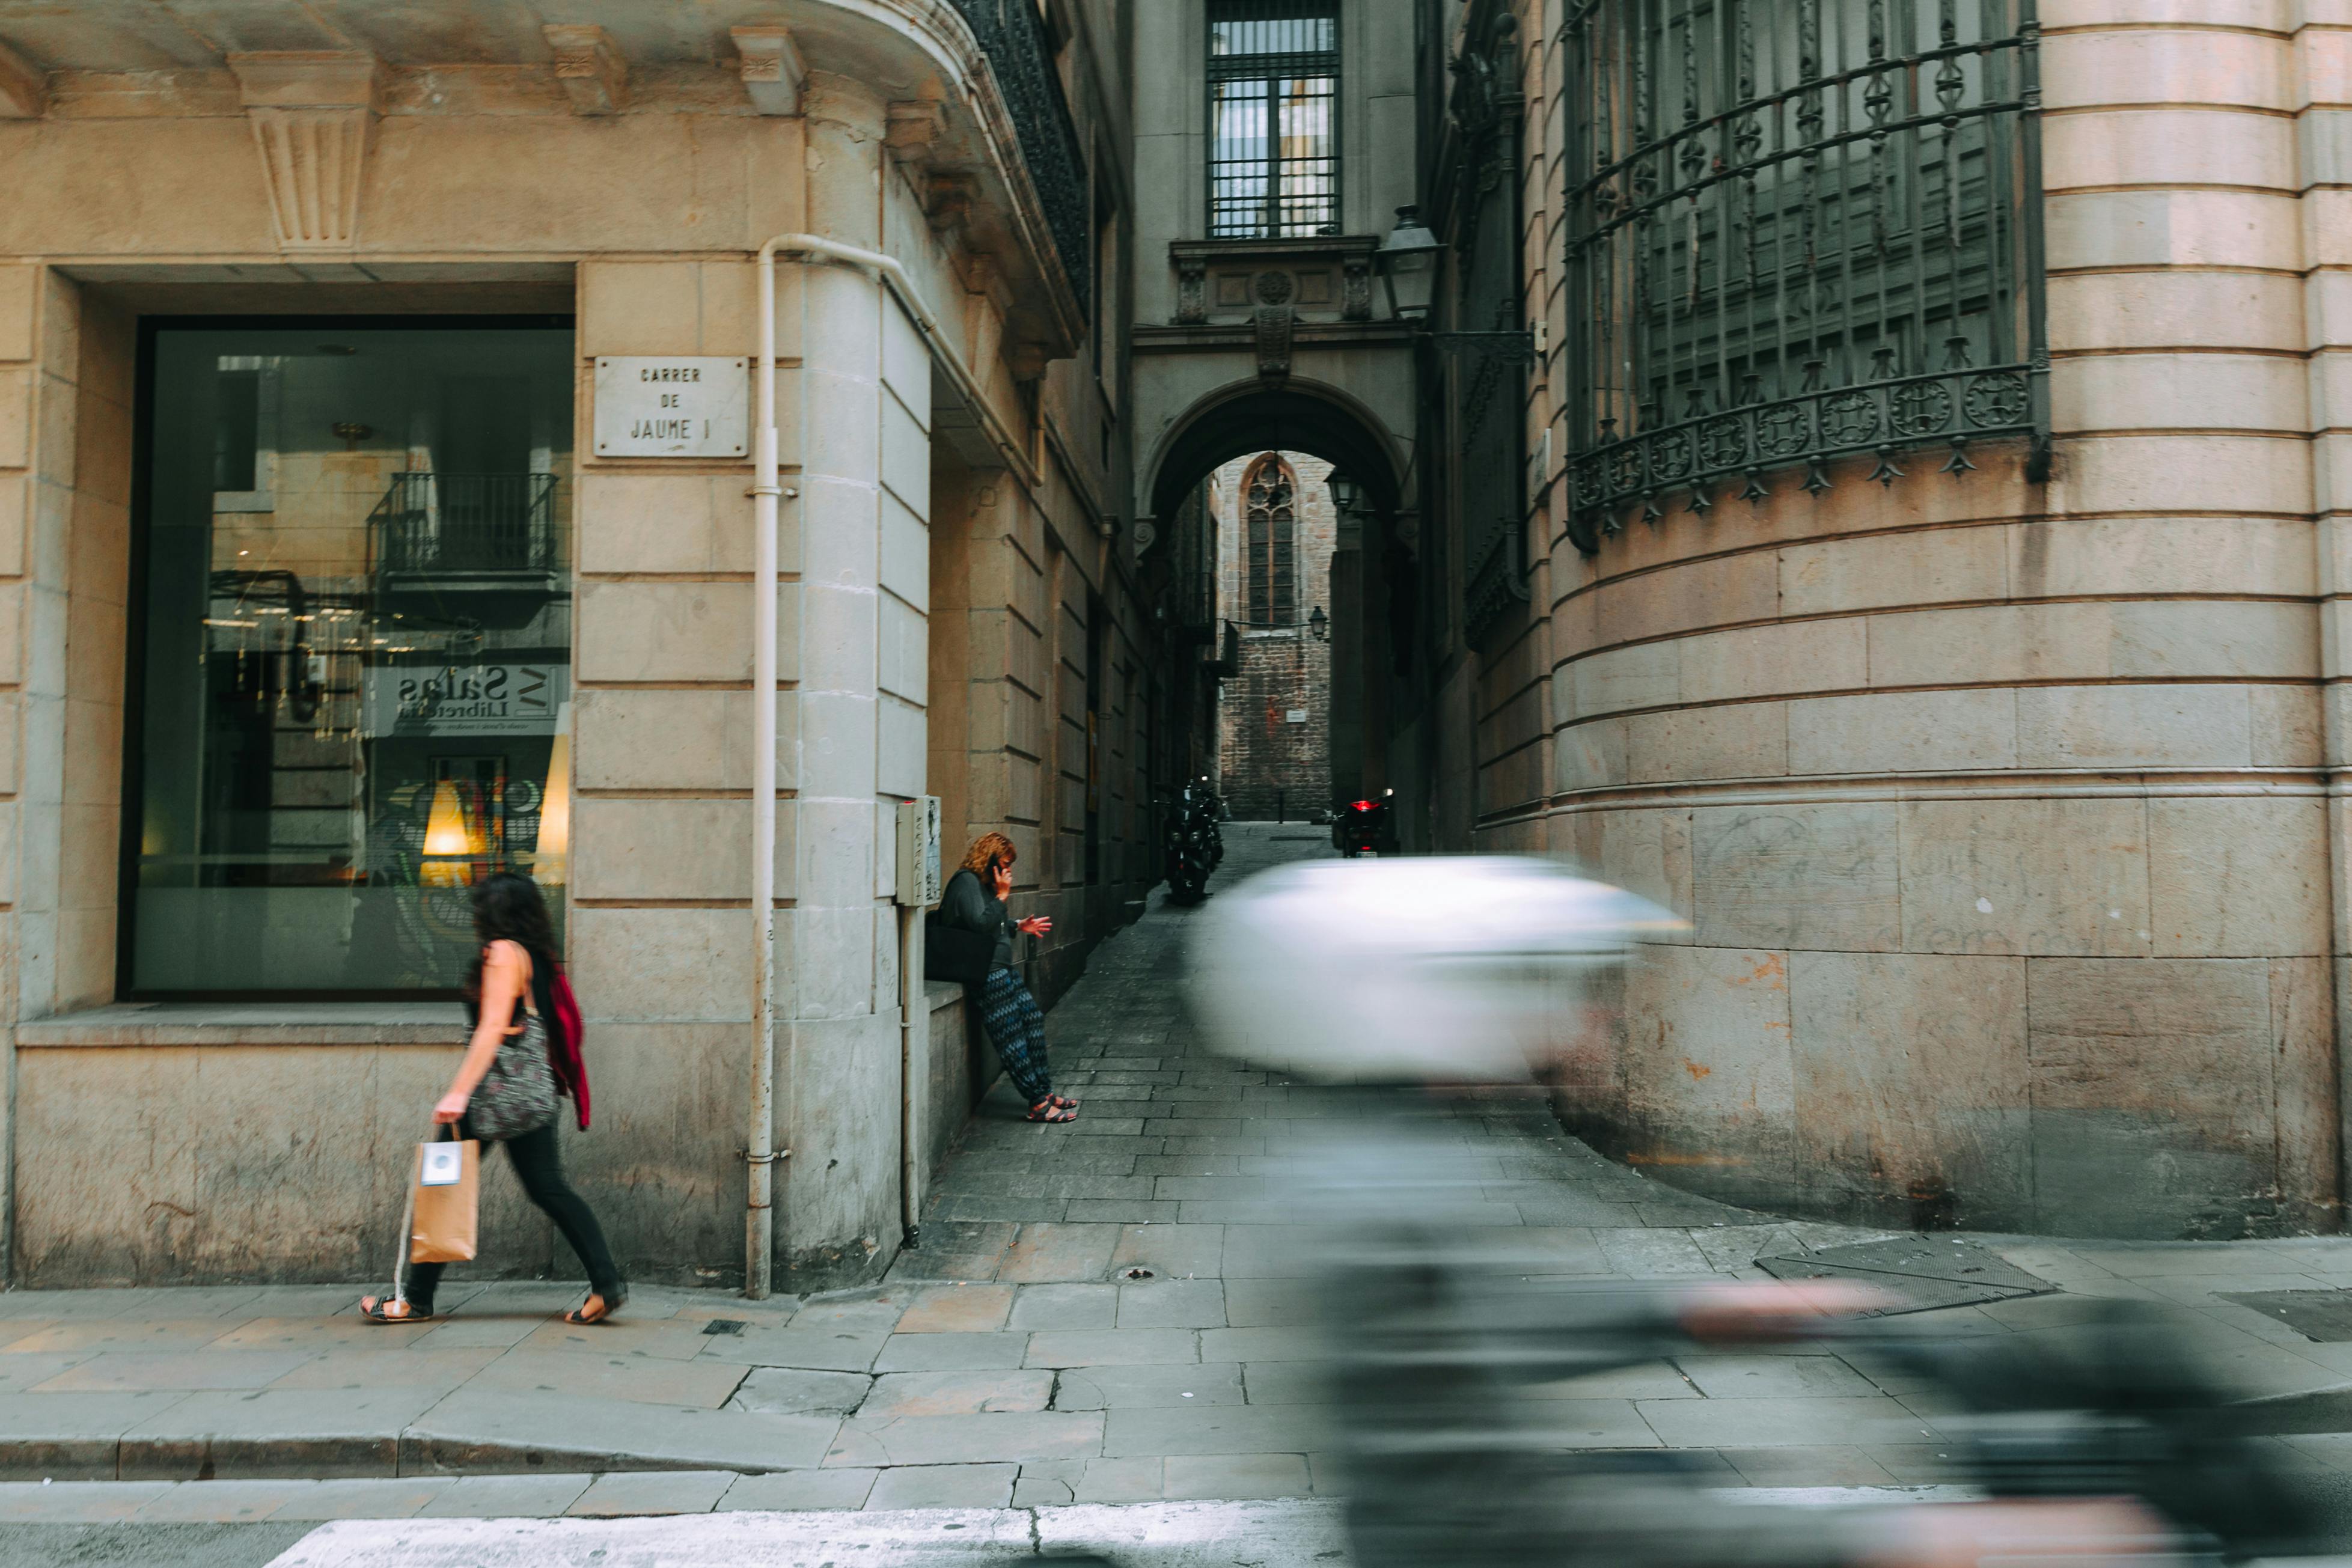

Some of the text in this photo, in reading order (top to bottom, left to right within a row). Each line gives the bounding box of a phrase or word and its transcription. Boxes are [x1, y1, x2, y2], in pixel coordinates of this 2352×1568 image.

[641, 368, 701, 382] CARRER
[661, 394, 680, 407] DE
[631, 419, 709, 439] JAUME I
